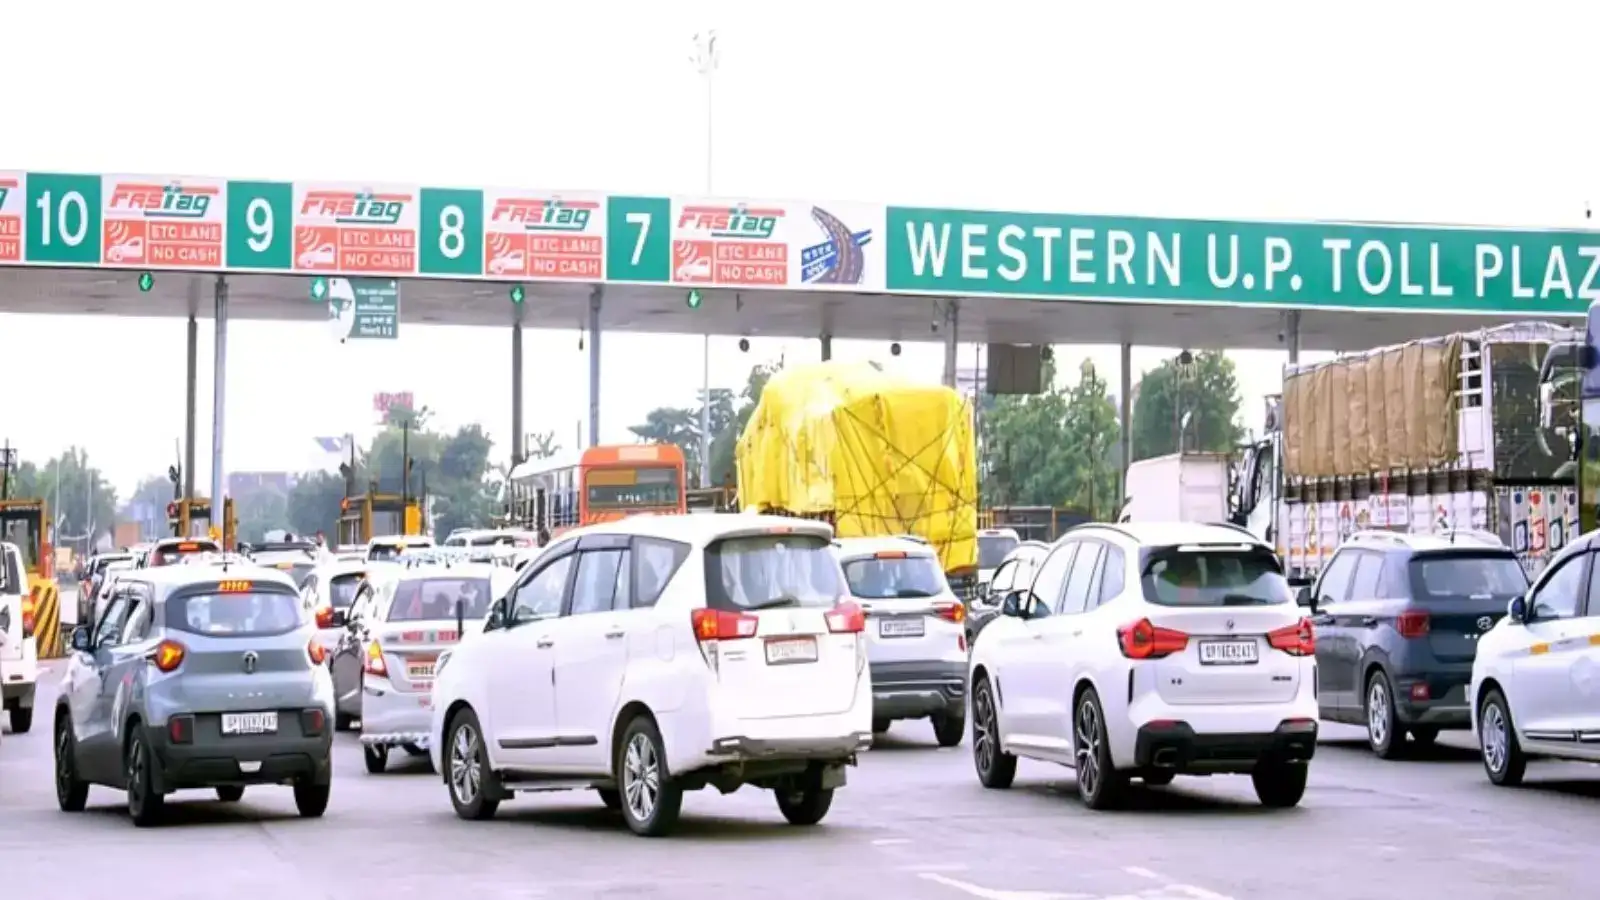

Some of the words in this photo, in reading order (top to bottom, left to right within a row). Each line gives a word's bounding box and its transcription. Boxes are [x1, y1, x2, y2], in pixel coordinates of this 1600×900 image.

[36, 190, 88, 246] 10
[246, 198, 274, 252] 9
[151, 224, 177, 239] ETC
[182, 224, 219, 240] LANE
[343, 231, 369, 245] ETC
[374, 232, 411, 246] LANE
[439, 204, 465, 259] 8
[533, 238, 558, 251] ETC
[562, 239, 599, 252] LANE
[626, 213, 651, 266] 7
[154, 246, 174, 260] NO
[179, 247, 217, 261] CASH
[345, 253, 367, 266] NO
[371, 254, 411, 267] CASH
[717, 245, 744, 259] ETC
[749, 246, 783, 260] LANE
[905, 221, 1181, 287] WESTERN
[1207, 233, 1303, 291] U.P.
[1323, 239, 1453, 295] TOLL
[534, 260, 556, 272] NO
[560, 261, 598, 273] CASH
[721, 265, 741, 279] NO
[745, 266, 783, 280] CASH
